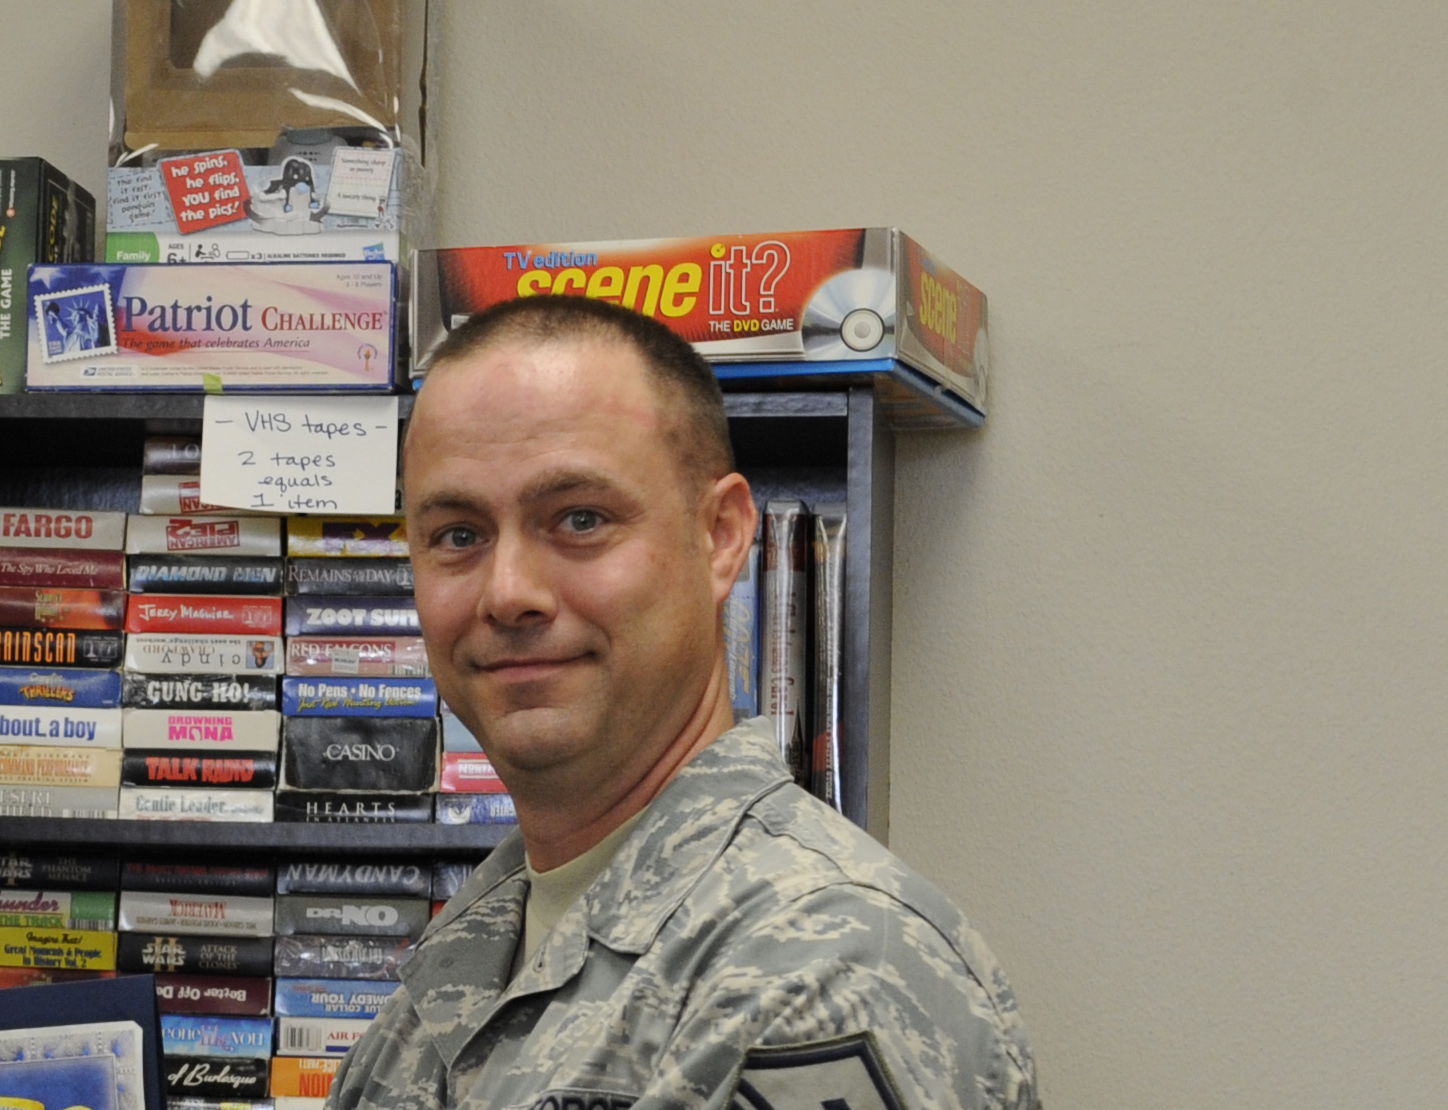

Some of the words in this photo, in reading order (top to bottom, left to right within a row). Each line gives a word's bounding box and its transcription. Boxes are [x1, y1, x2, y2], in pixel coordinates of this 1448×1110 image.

[171, 165, 189, 178] he
[186, 176, 204, 188] he
[182, 193, 210, 207] YOU
[213, 186, 240, 201] find
[180, 209, 204, 222] the
[208, 201, 240, 219] pics!
[116, 250, 151, 263] Family
[503, 252, 530, 271] TV
[533, 250, 598, 269] edition
[1, 268, 12, 309] GAME
[516, 261, 703, 318] scene
[122, 296, 252, 333] Patriot
[260, 306, 383, 331] CHALLENGE
[0, 313, 11, 339] THE
[708, 320, 731, 332] THE
[733, 319, 760, 332] DVD
[761, 318, 794, 331] GAME
[122, 337, 142, 349] The
[144, 339, 175, 351] game
[179, 337, 202, 349] that
[204, 337, 260, 349] celebrates
[262, 337, 311, 348] America
[245, 411, 292, 433] VHS
[301, 413, 368, 439] tapes
[237, 451, 256, 467] 2
[270, 452, 336, 471] tapes
[257, 472, 333, 492] equals
[250, 494, 274, 508] 1
[279, 493, 338, 510] item
[3, 513, 93, 539] FARGO
[168, 537, 239, 551] AMERICAN
[136, 565, 227, 581] DIAMOND
[306, 608, 368, 626] ZOOT
[371, 609, 419, 627] SUIT
[147, 681, 203, 702] GUNG
[213, 681, 250, 703] HO!
[298, 683, 315, 697] No
[319, 684, 347, 698] Pens
[359, 684, 375, 698] No
[379, 685, 422, 699] Fences
[49, 719, 60, 737] a
[63, 717, 96, 741] boy
[168, 716, 233, 726] DROWNING
[323, 744, 396, 762] CASINO
[146, 756, 198, 782] TALK
[201, 758, 254, 784] RADIO
[306, 801, 395, 815] HEARTS
[286, 863, 421, 884] CANDYMAN
[169, 900, 226, 919] MAVERICK
[175, 985, 201, 1000] Off
[204, 985, 247, 1001] Better
[185, 1063, 256, 1086] Burlesque
